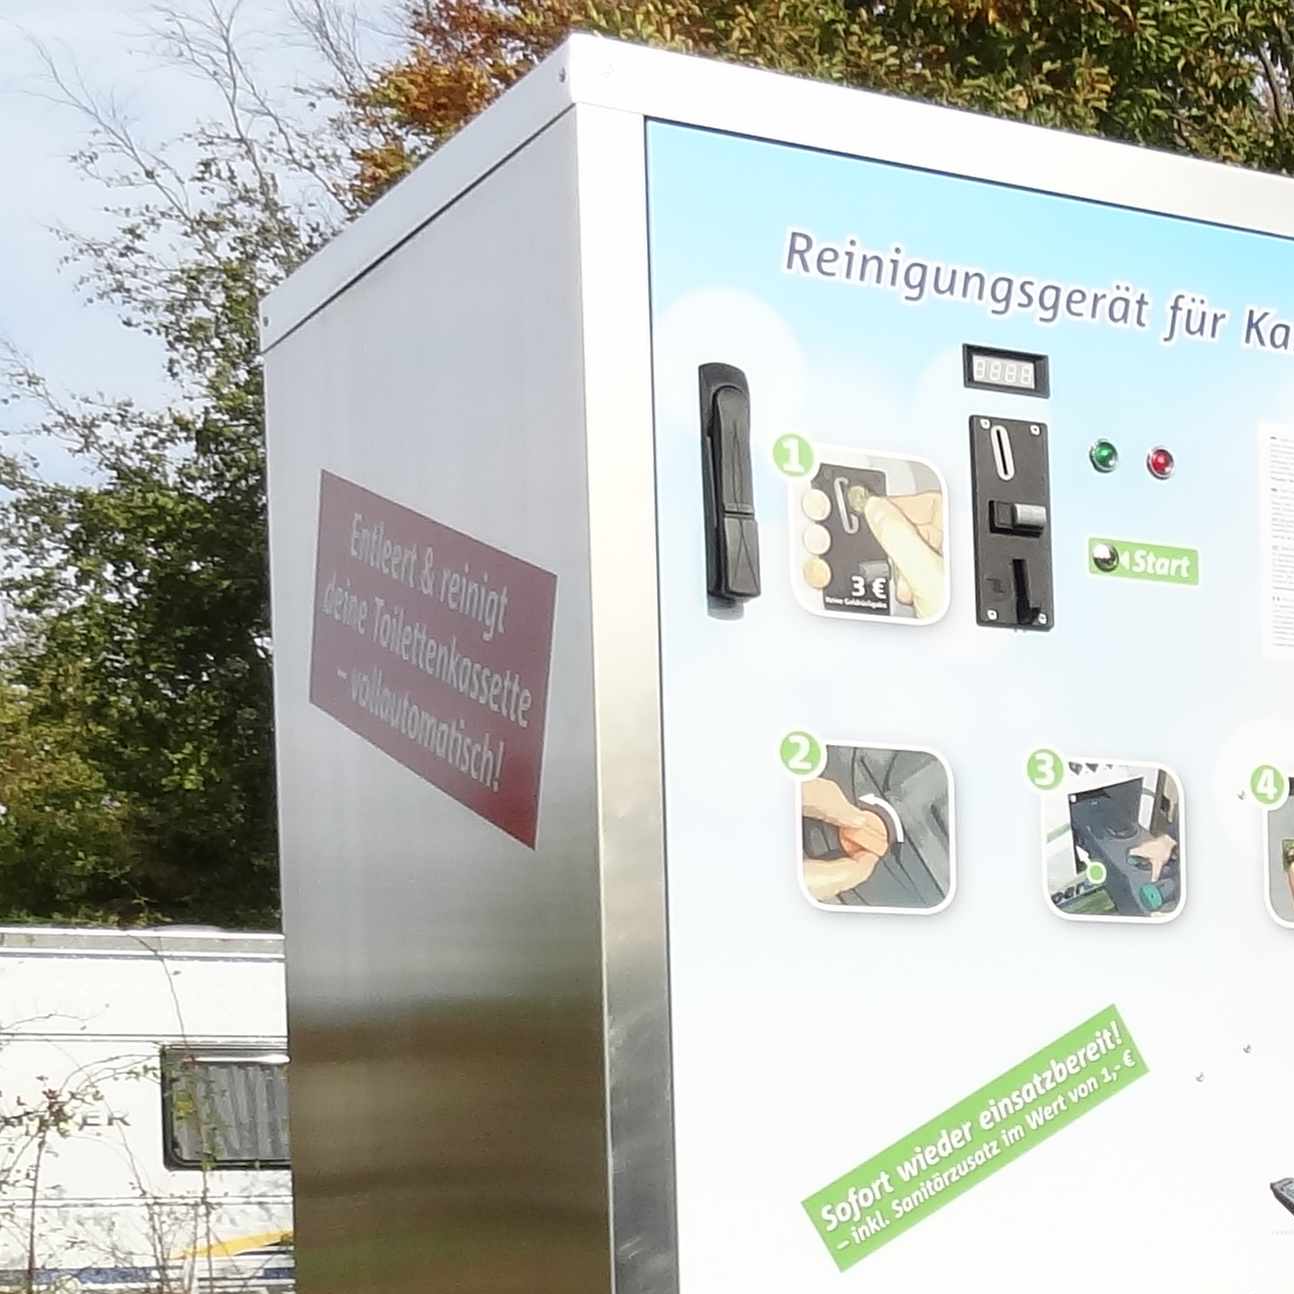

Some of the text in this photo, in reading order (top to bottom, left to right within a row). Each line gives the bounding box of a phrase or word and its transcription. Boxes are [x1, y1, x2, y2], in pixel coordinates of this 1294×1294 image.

[786, 231, 1149, 328] Reinigungsgerät
[1163, 294, 1227, 342] für
[783, 438, 805, 473] 1
[350, 512, 509, 641] Entleert & reinigt
[851, 575, 888, 600] 3 €
[1131, 549, 1192, 579] Start
[322, 572, 533, 728] deine Toilettenkassette
[350, 666, 505, 793] vollautomatisch!
[786, 735, 812, 770] 2
[1034, 751, 1056, 788] 3
[1255, 767, 1278, 800] 4
[821, 1020, 1123, 1232] Sofort wieder einsatzbereit!
[852, 1210, 891, 1245] inkl.
[892, 1138, 1001, 1220] Sanitärzusatz
[1000, 1123, 1025, 1148] im
[1025, 1095, 1068, 1132] Wert
[1068, 1074, 1099, 1104] von
[1122, 1049, 1136, 1069] €
